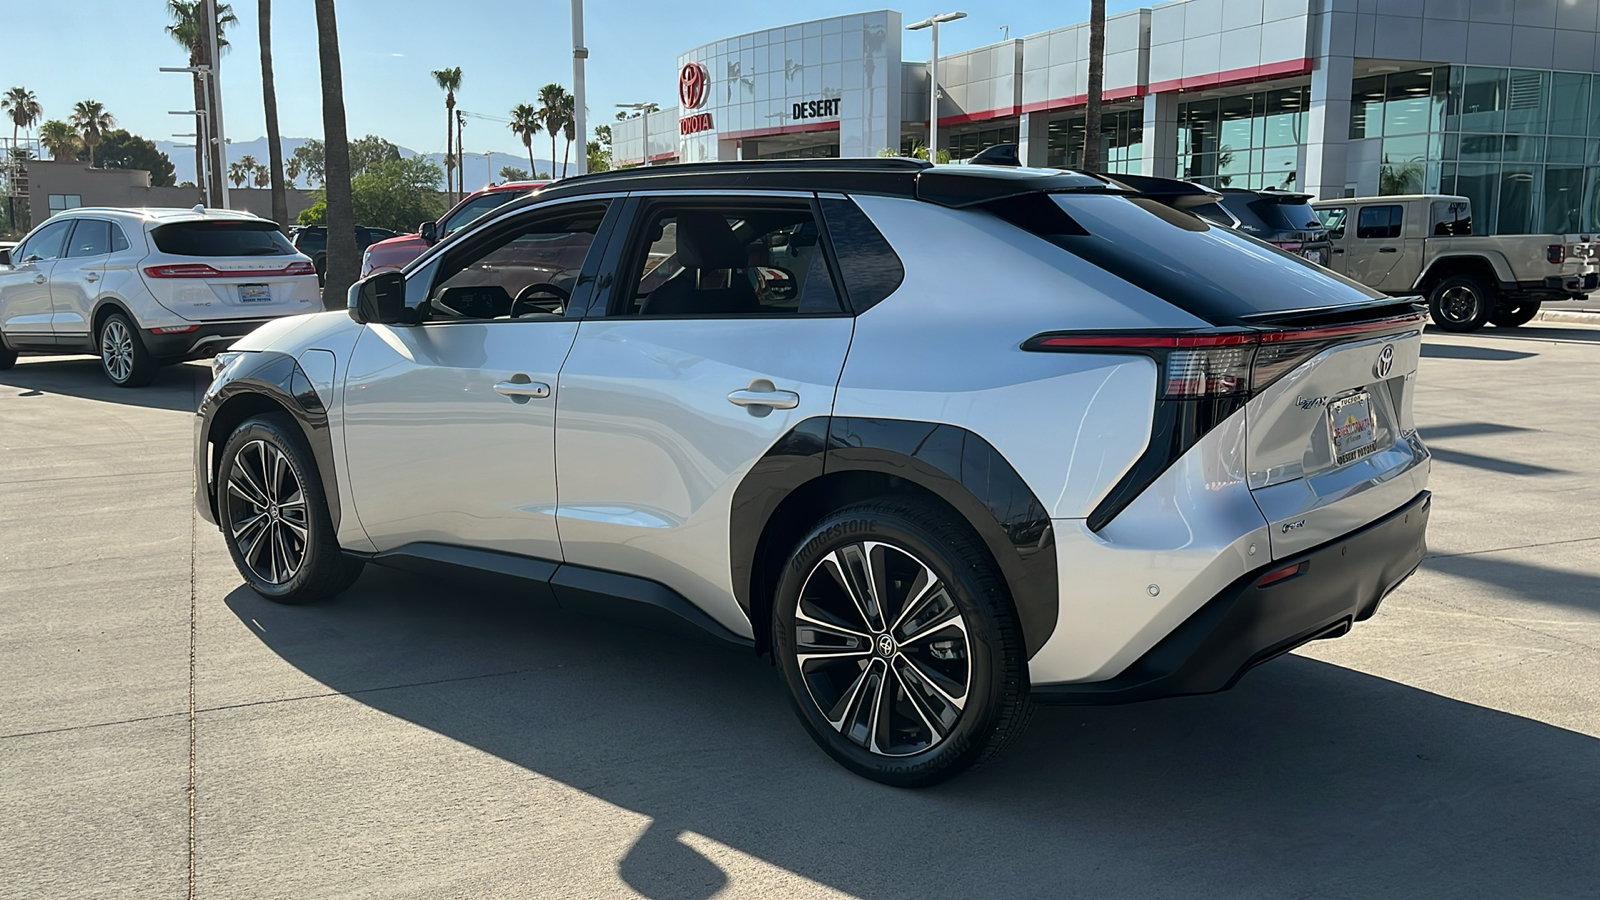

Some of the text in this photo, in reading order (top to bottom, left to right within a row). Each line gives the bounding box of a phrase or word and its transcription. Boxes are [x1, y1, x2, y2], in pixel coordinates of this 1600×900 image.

[792, 98, 841, 120] DESERT
[679, 113, 711, 135] TOYOTA
[1341, 395, 1361, 406] TUCSON
[1338, 451, 1357, 465] DESERT
[791, 519, 877, 572] BRIDGESTONE
